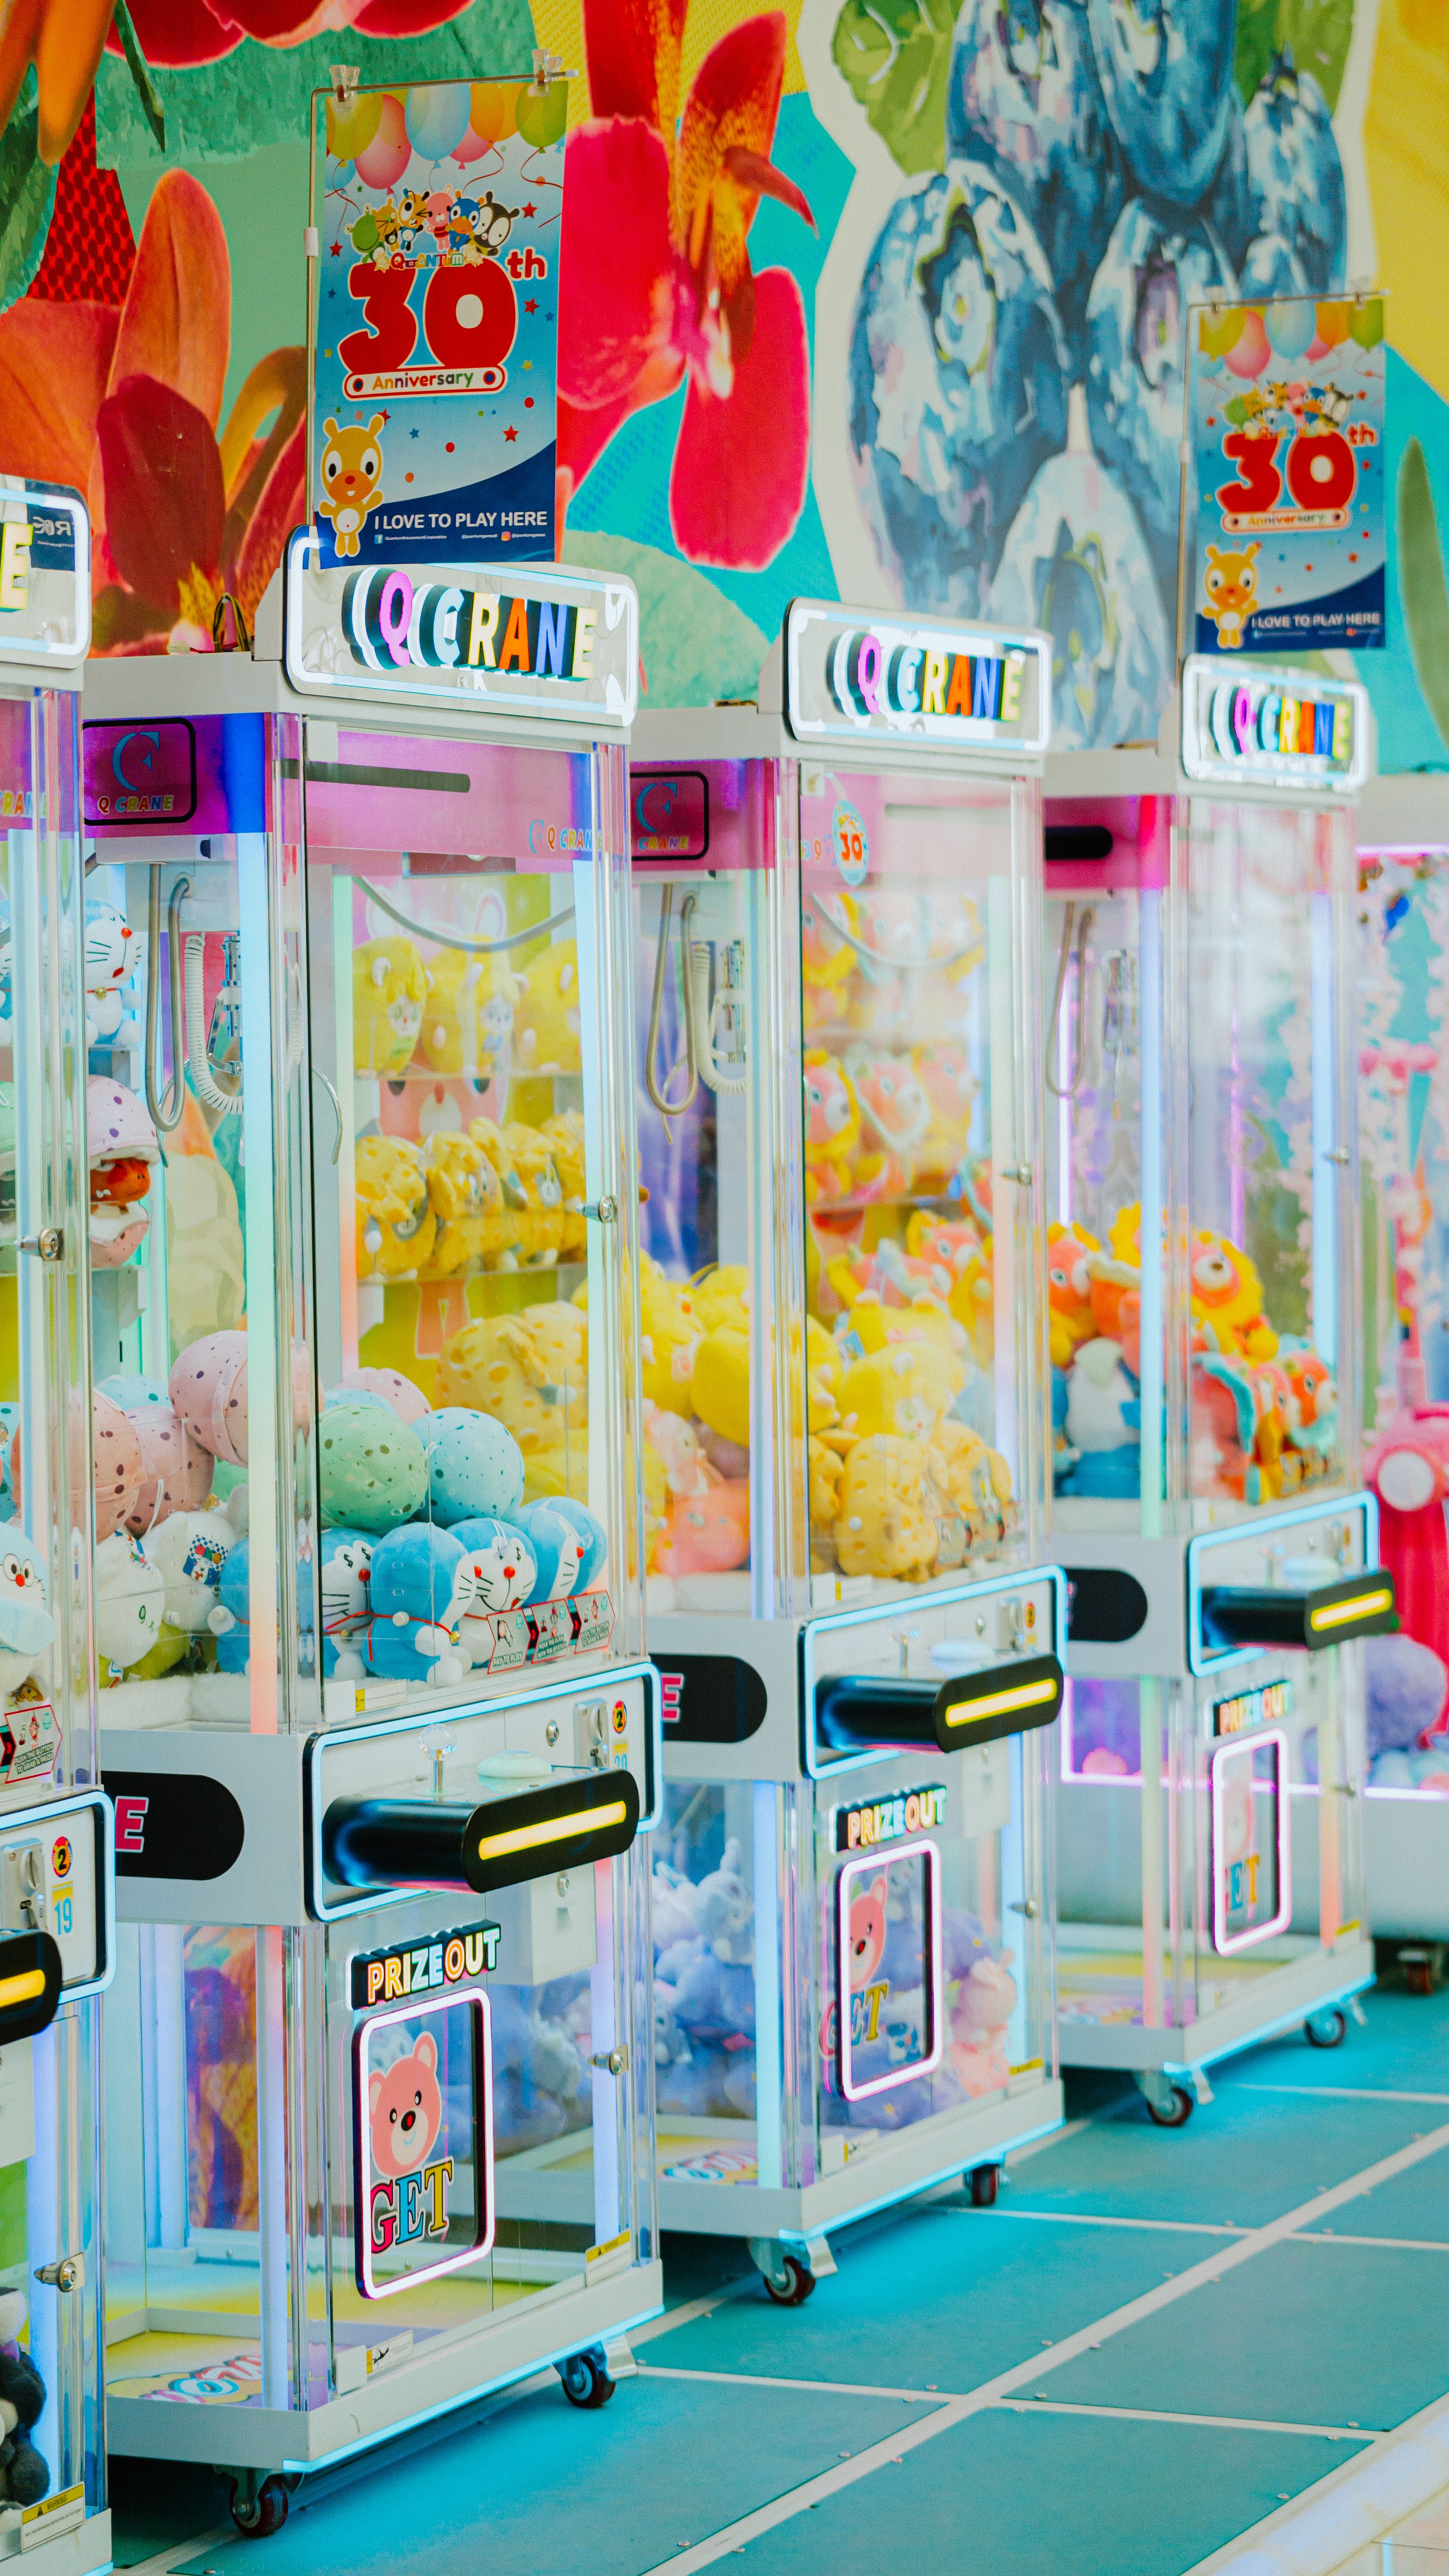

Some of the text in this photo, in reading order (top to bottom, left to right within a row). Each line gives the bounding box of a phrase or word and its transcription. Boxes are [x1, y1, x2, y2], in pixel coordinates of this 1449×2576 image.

[372, 372, 473, 391] Anniversary
[374, 511, 548, 530] I LOVE TO PLAY HERE
[1247, 513, 1325, 526] Anniversary
[1258, 615, 1290, 628] LOVE
[1293, 614, 1310, 627] TO
[1313, 613, 1343, 626] PLAY
[1346, 611, 1380, 625] HERE
[432, 586, 598, 680] CRANE
[98, 795, 174, 814] Q CRANE
[617, 1710, 623, 1728] 2
[58, 1848, 66, 1870] 2
[1225, 1854, 1260, 1911] ET
[54, 1898, 72, 1935] 19
[370, 2160, 453, 2254] GET
[47, 2494, 67, 2509] WARNING
